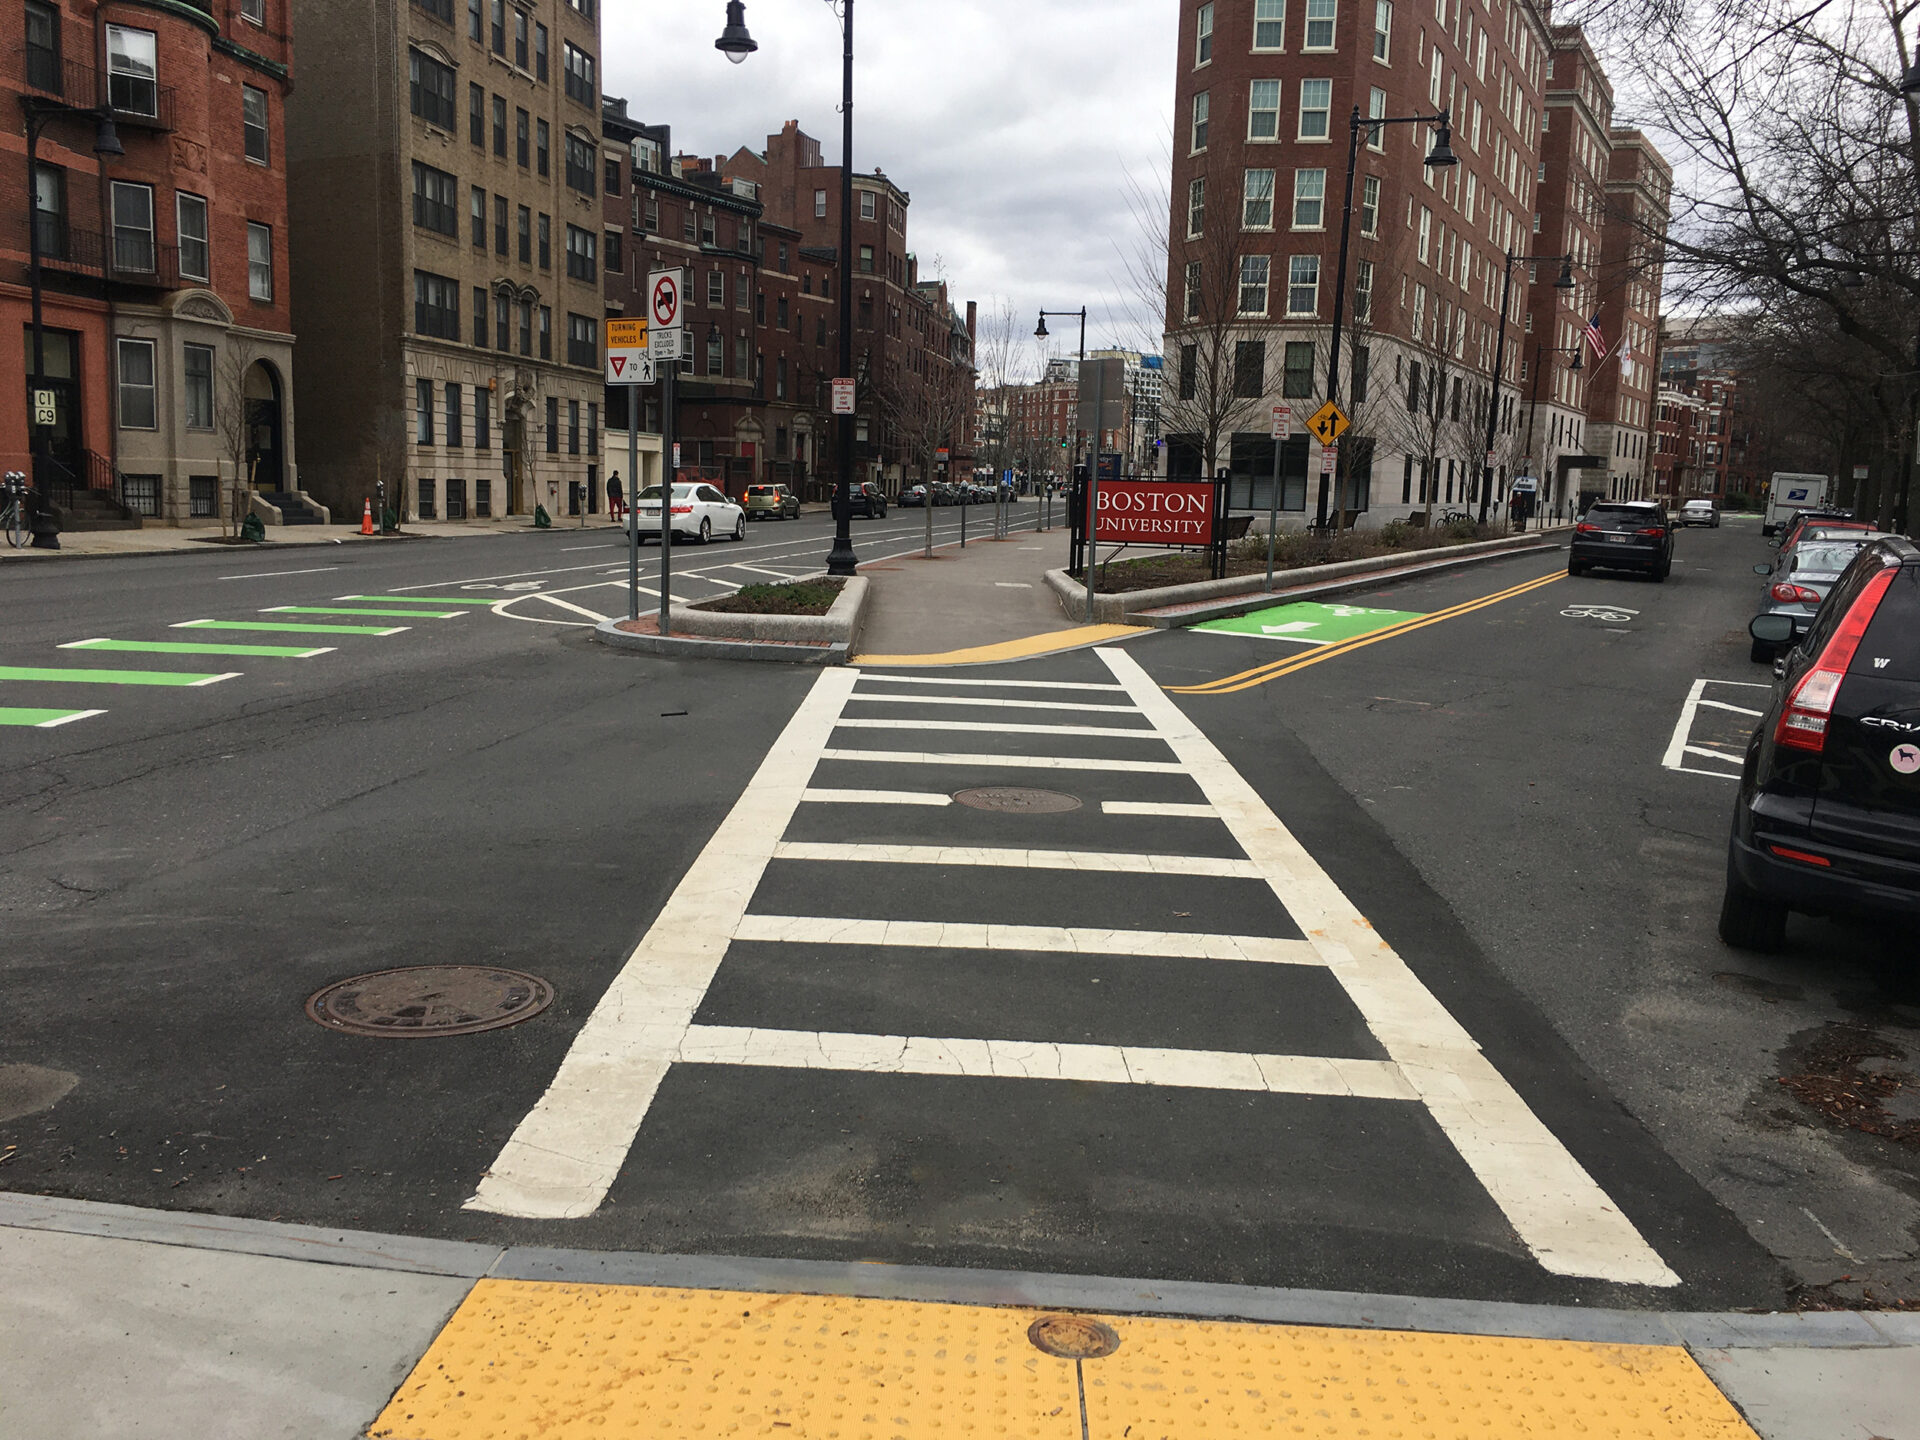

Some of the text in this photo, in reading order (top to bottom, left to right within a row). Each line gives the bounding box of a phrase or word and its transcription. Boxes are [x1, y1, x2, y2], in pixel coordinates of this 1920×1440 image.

[611, 323, 636, 332] TURNING
[610, 335, 637, 344] VEHICLES
[656, 331, 673, 339] TRUCKS
[654, 340, 675, 348] EXCLUDED
[629, 363, 638, 371] TO
[38, 410, 54, 422] C9
[1096, 491, 1208, 513] BOSTON
[1873, 657, 1891, 669] W
